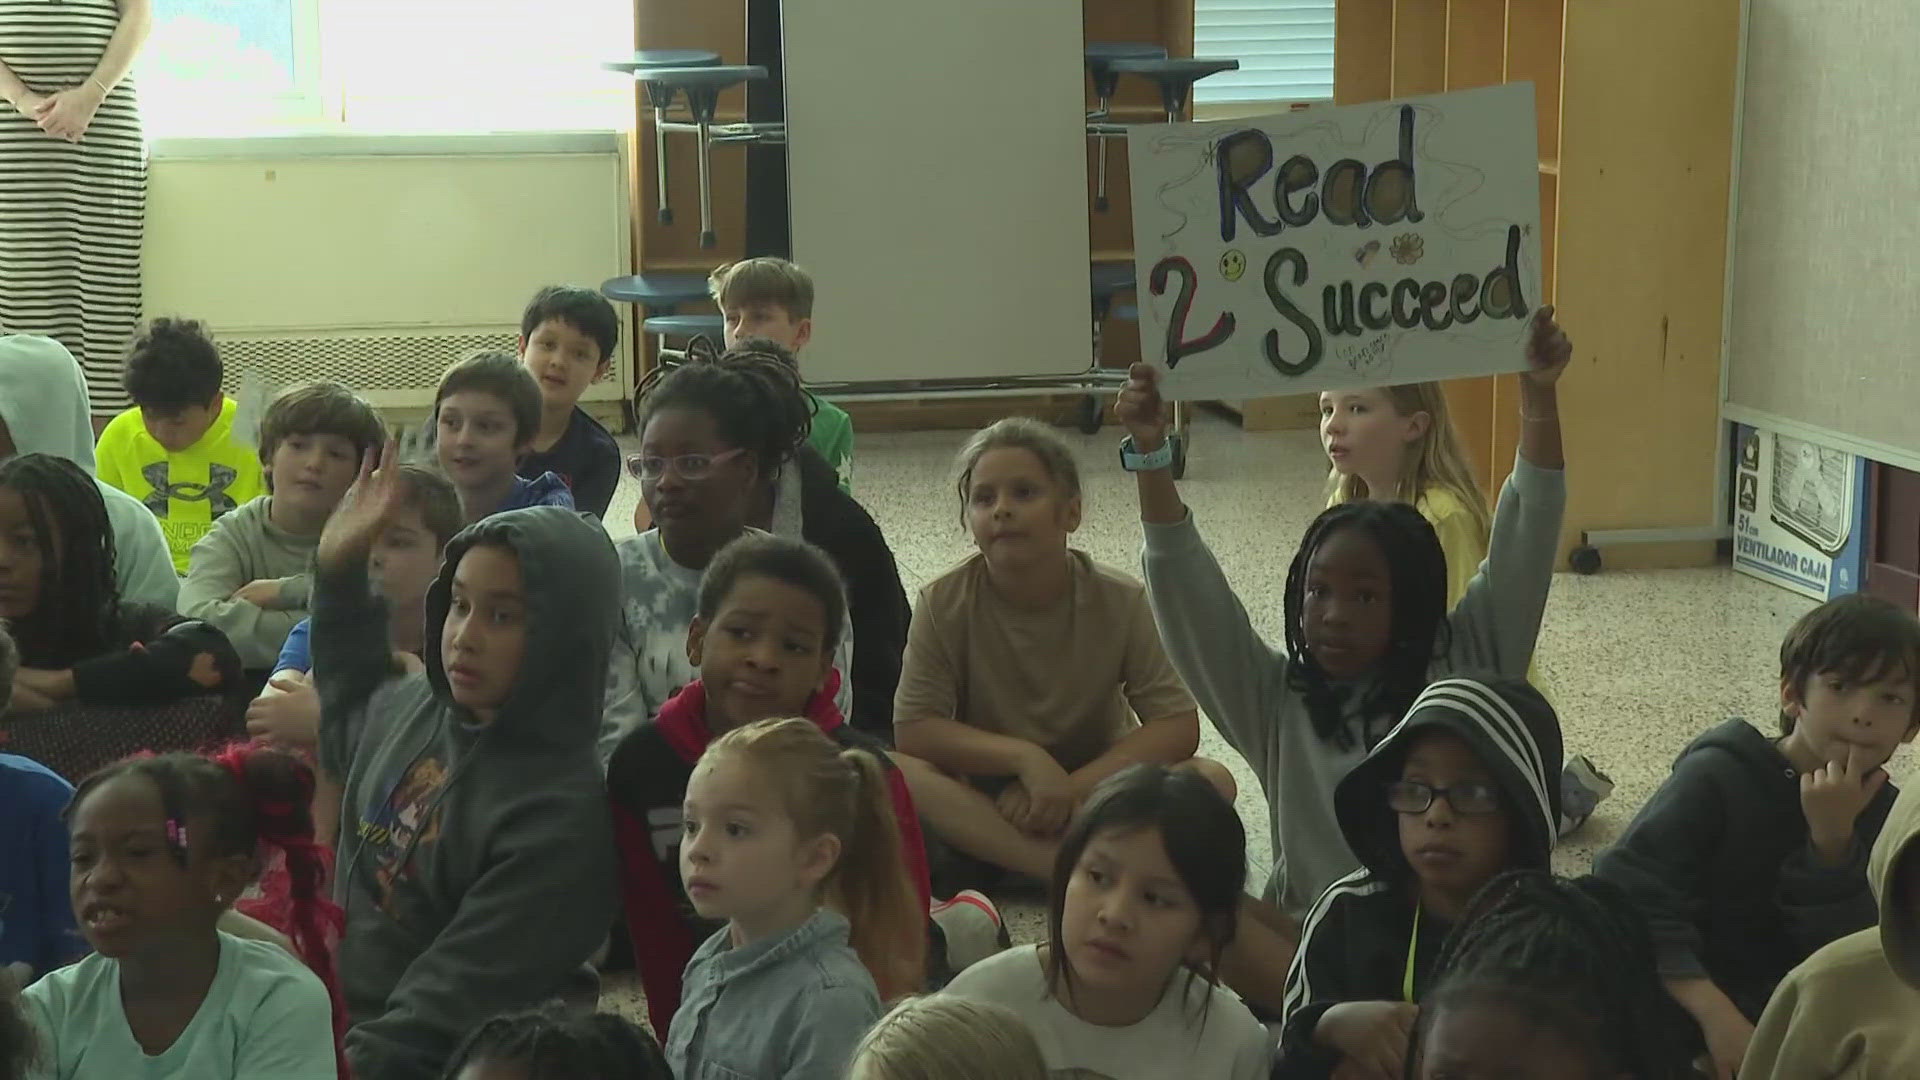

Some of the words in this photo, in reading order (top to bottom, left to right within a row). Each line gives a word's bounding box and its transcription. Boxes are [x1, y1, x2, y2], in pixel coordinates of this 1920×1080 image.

[1217, 104, 1424, 242] Read
[1149, 256, 1236, 369] 2
[1264, 225, 1529, 376] Succeed
[1737, 534, 1798, 570] VENTILADOR
[1800, 556, 1828, 581] CAJA
